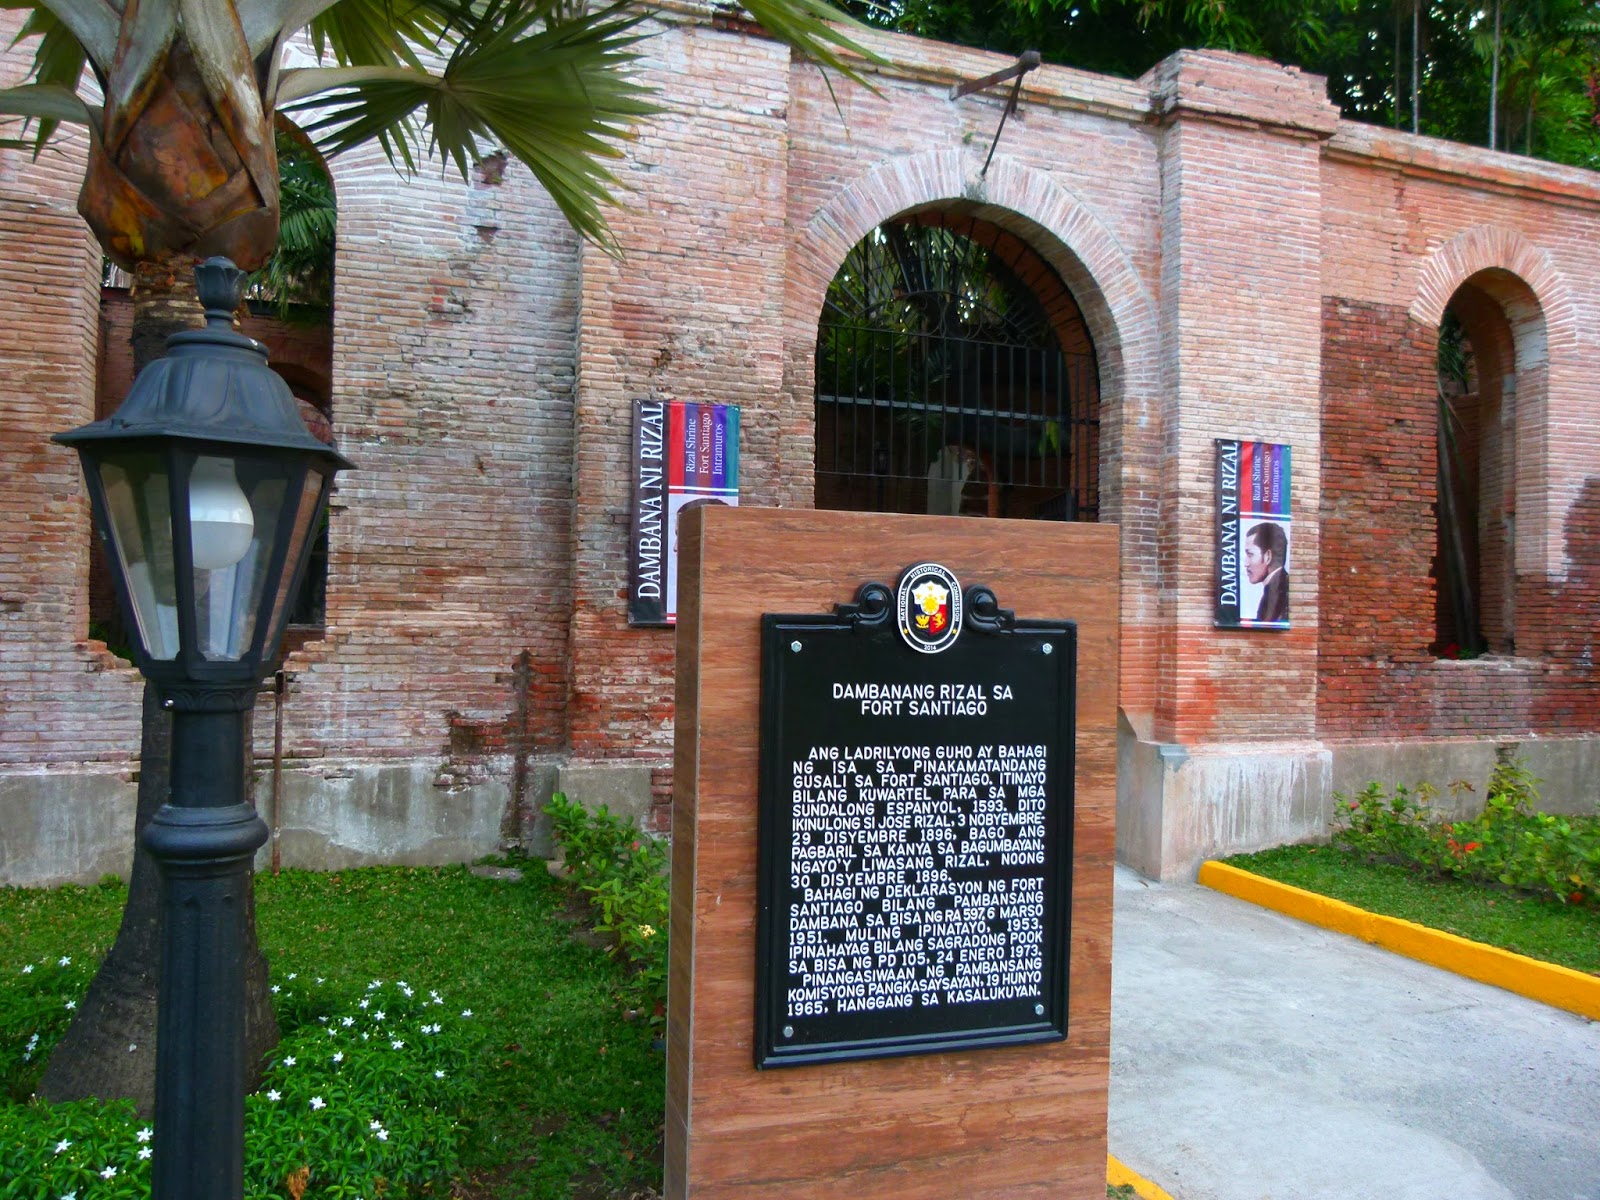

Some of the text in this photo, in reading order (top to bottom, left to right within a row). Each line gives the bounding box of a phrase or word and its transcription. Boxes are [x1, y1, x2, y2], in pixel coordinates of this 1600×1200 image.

[686, 418, 696, 473] Rizal Shrine
[700, 413, 712, 474] Fort Santiago
[713, 423, 723, 475] Intramuros
[1253, 456, 1261, 501] Rizal Shrine
[638, 402, 664, 599] DAMBANA NI RIZAL
[1221, 442, 1238, 606] DAMBANA NI RIZAL
[911, 567, 945, 578] HISTORICAL
[833, 683, 1013, 700] DAMBANANG RIZAL SA
[862, 701, 987, 716] FORT SANTIAGO
[809, 745, 1046, 760] ANG LADRILYONG GUHO AY BAHAGI
[793, 759, 1046, 774] NG ISA SA PINAKAMATANDANG
[793, 772, 1046, 789] GUSALI SA FORT SANTIAGO. ITINAYO
[793, 786, 1045, 803] BILANG KUWARTEL PARA SA MGA
[793, 799, 1045, 817] SUNDALONG ESPANYOL, 1593. DITO
[793, 817, 860, 831] IKINULONG
[864, 816, 875, 829] SI
[878, 815, 911, 828] JOSE
[914, 814, 955, 827] RIZAL,
[958, 814, 965, 826] 3
[792, 826, 1045, 845] 29 DISYEMBRE 1896, BAGO ANG
[792, 839, 1044, 859] PAGBARIL SA KANYA SA BAGUMBAYAN,
[862, 856, 934, 871] LIWASANG
[945, 855, 989, 868] RIZAL,
[1002, 852, 1044, 865] NOONG
[791, 870, 952, 887] 30 DISYEMBRE 1896.
[805, 877, 1044, 901] BAHAGI NG DEKLARASYON NG FORT
[790, 892, 1043, 917] SANTIAGO BILANG PAMBANSANG
[790, 915, 858, 930] DAMBANA
[867, 914, 884, 926] SA
[890, 912, 921, 925] BISA
[925, 911, 942, 923] NG
[945, 910, 961, 922] RA
[987, 907, 995, 919] 6
[1000, 904, 1043, 918] MARSO
[790, 918, 1042, 945] 1951. MULING IPINATAYO, 1953.
[790, 931, 1042, 959] IPINAHAYAG BILANG SAGRADONG POOK
[789, 945, 1041, 973] SA BISA NG PD 105, 24 ENERO 1973.
[803, 959, 1042, 986] PINANGASIWAAN NG PAMBANSANG
[788, 971, 1041, 1002] KOMISYONG PANGKASAYSAYAN, 19 HUNYO
[788, 985, 1040, 1016] 1965, HANGGANG SA KASALUKUYAN.
